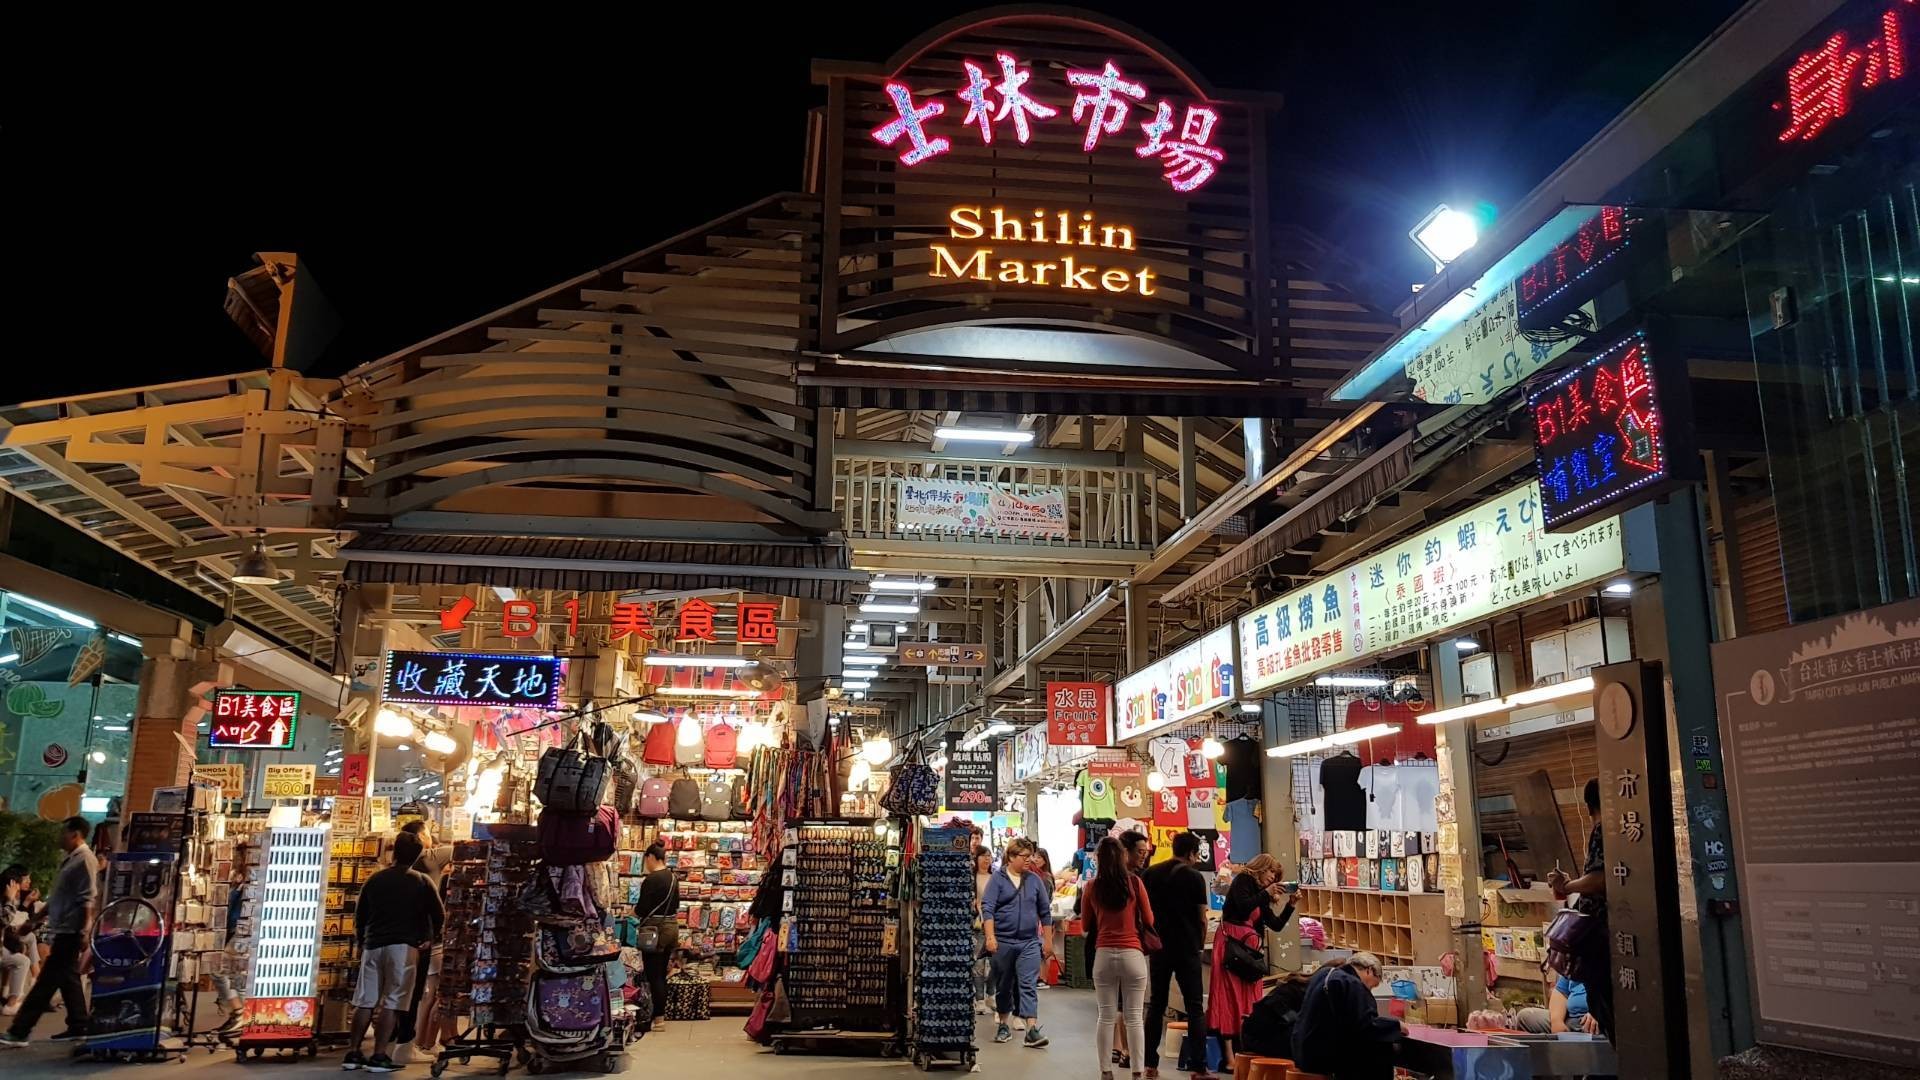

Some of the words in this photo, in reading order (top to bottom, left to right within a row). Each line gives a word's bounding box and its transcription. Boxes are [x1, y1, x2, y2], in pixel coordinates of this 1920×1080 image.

[872, 52, 1224, 192] 士林市場
[949, 204, 1137, 251] Shilin
[928, 243, 1157, 297] Market
[1537, 348, 1649, 444] B1美食區
[1369, 520, 1477, 590] 迷你釣蝦
[1496, 491, 1538, 536] えび
[1254, 583, 1342, 650] 高級撈魚
[396, 659, 549, 700] 收藏天地
[1055, 688, 1097, 708] 水果
[217, 694, 296, 718] B1美食區
[1054, 709, 1097, 721] Fruit
[215, 725, 240, 737] 入口
[268, 767, 281, 775] Big
[275, 781, 304, 795] 100
[960, 790, 986, 803] 290
[1615, 768, 1644, 843] 市場
